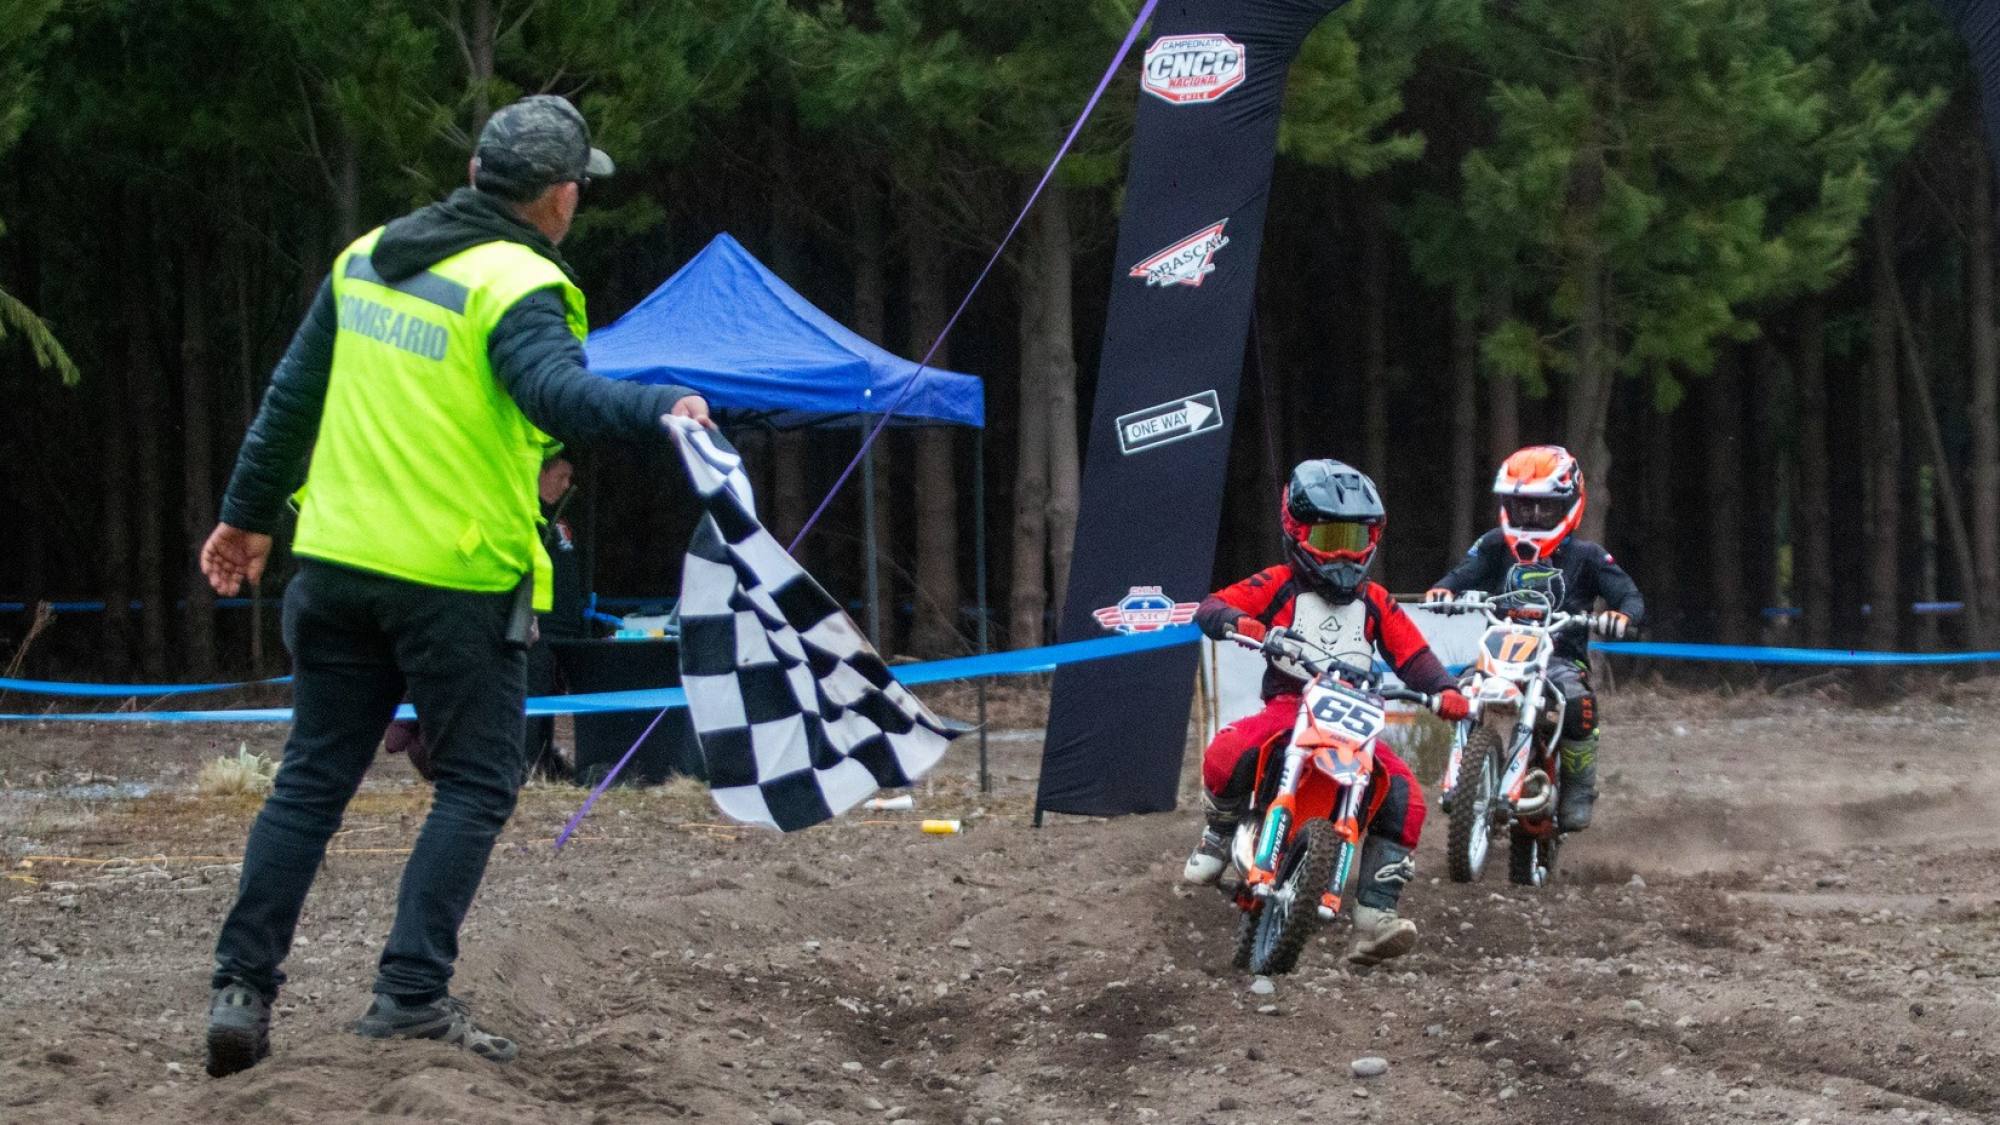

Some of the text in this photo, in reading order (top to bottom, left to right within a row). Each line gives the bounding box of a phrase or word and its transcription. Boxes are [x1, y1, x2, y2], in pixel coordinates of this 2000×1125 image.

[1162, 40, 1222, 49] CAMPEONATO
[1149, 50, 1238, 81] CNCC
[1168, 75, 1217, 88] NACIONAL
[338, 292, 449, 362] OMISARIO
[1131, 410, 1188, 438] ONE WAY
[1498, 634, 1539, 662] 17
[1311, 695, 1382, 737] 65
